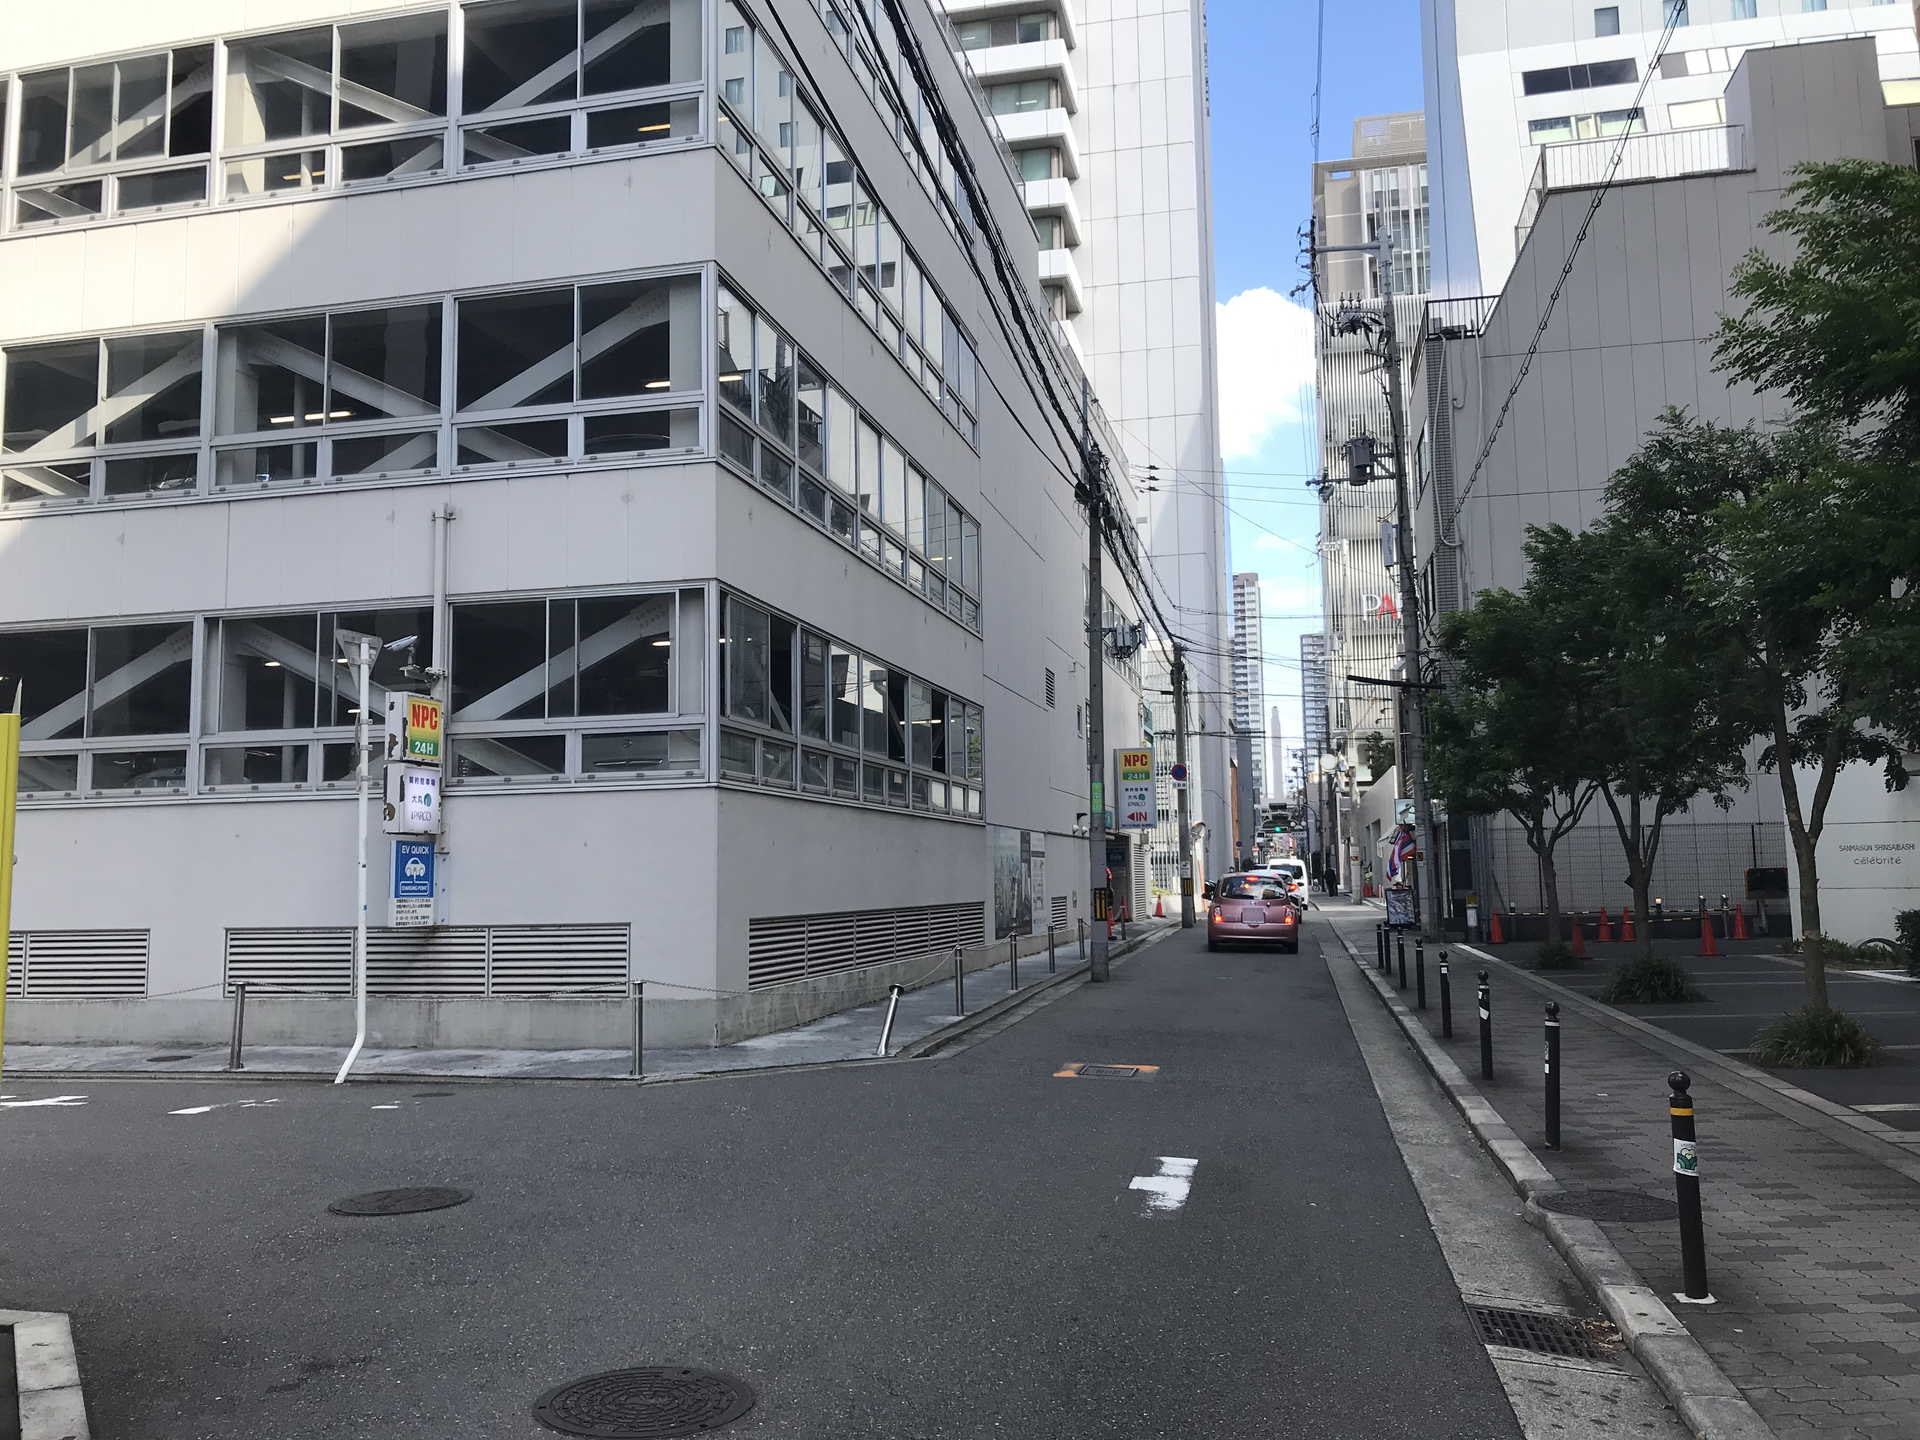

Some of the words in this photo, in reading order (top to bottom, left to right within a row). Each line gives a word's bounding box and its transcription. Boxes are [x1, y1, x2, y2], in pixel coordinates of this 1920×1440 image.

[411, 703, 438, 730] NPC
[414, 741, 434, 755] 24H
[1124, 754, 1148, 767] NPC
[1136, 812, 1148, 822] IN
[401, 845, 410, 854] EV
[411, 845, 430, 855] QUICK
